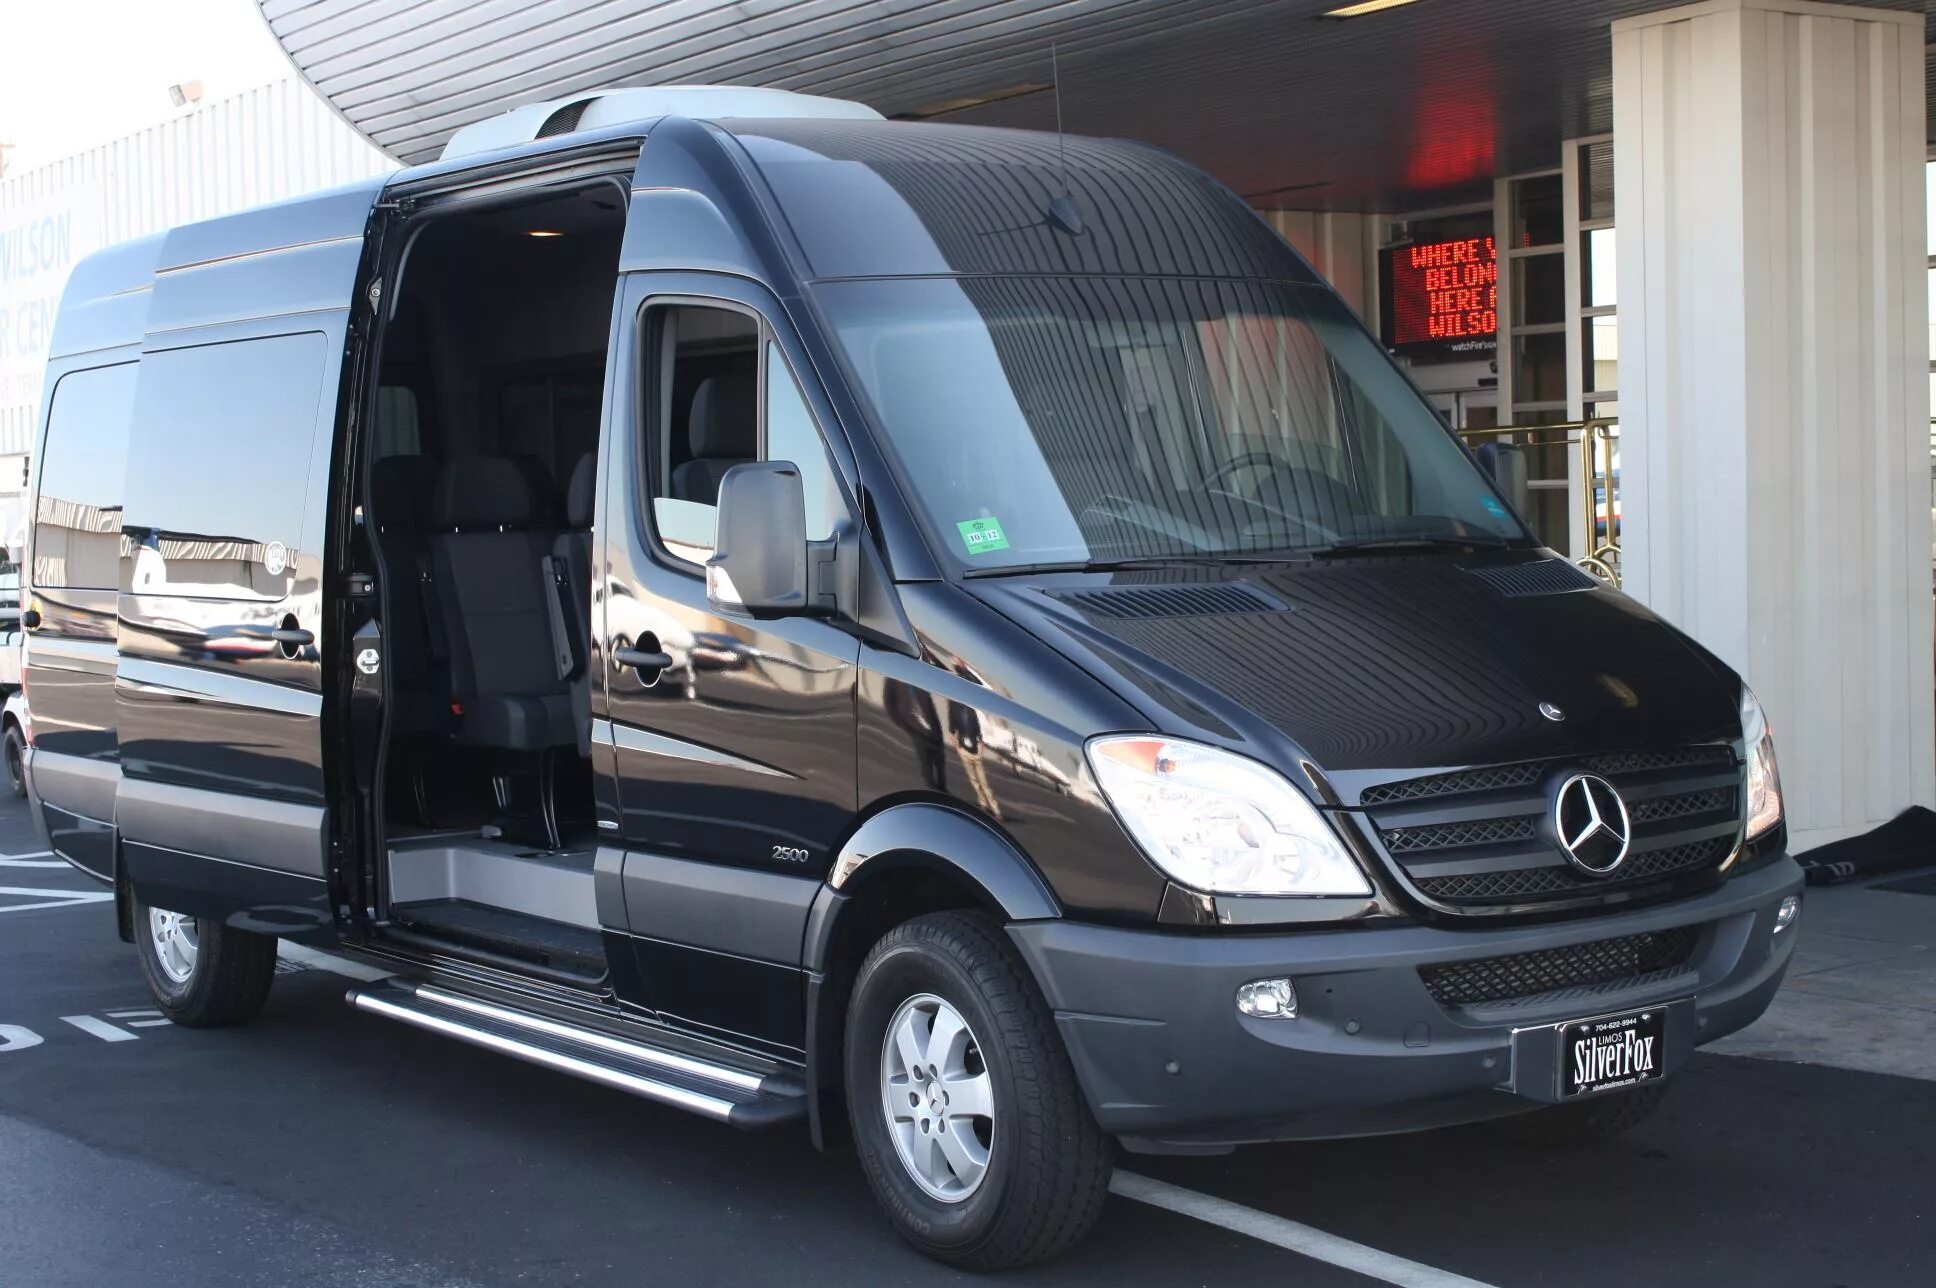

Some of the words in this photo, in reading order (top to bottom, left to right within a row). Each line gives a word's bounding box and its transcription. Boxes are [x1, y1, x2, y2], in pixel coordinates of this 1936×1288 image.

[1412, 240, 1479, 268] WHERE
[1427, 262, 1496, 290] BELON
[1431, 288, 1482, 313] HERE
[1429, 311, 1496, 338] WILSO
[771, 845, 809, 862] 2500
[1596, 1018, 1637, 1032] 704-622-9944
[1598, 1032, 1622, 1045] LIMOS
